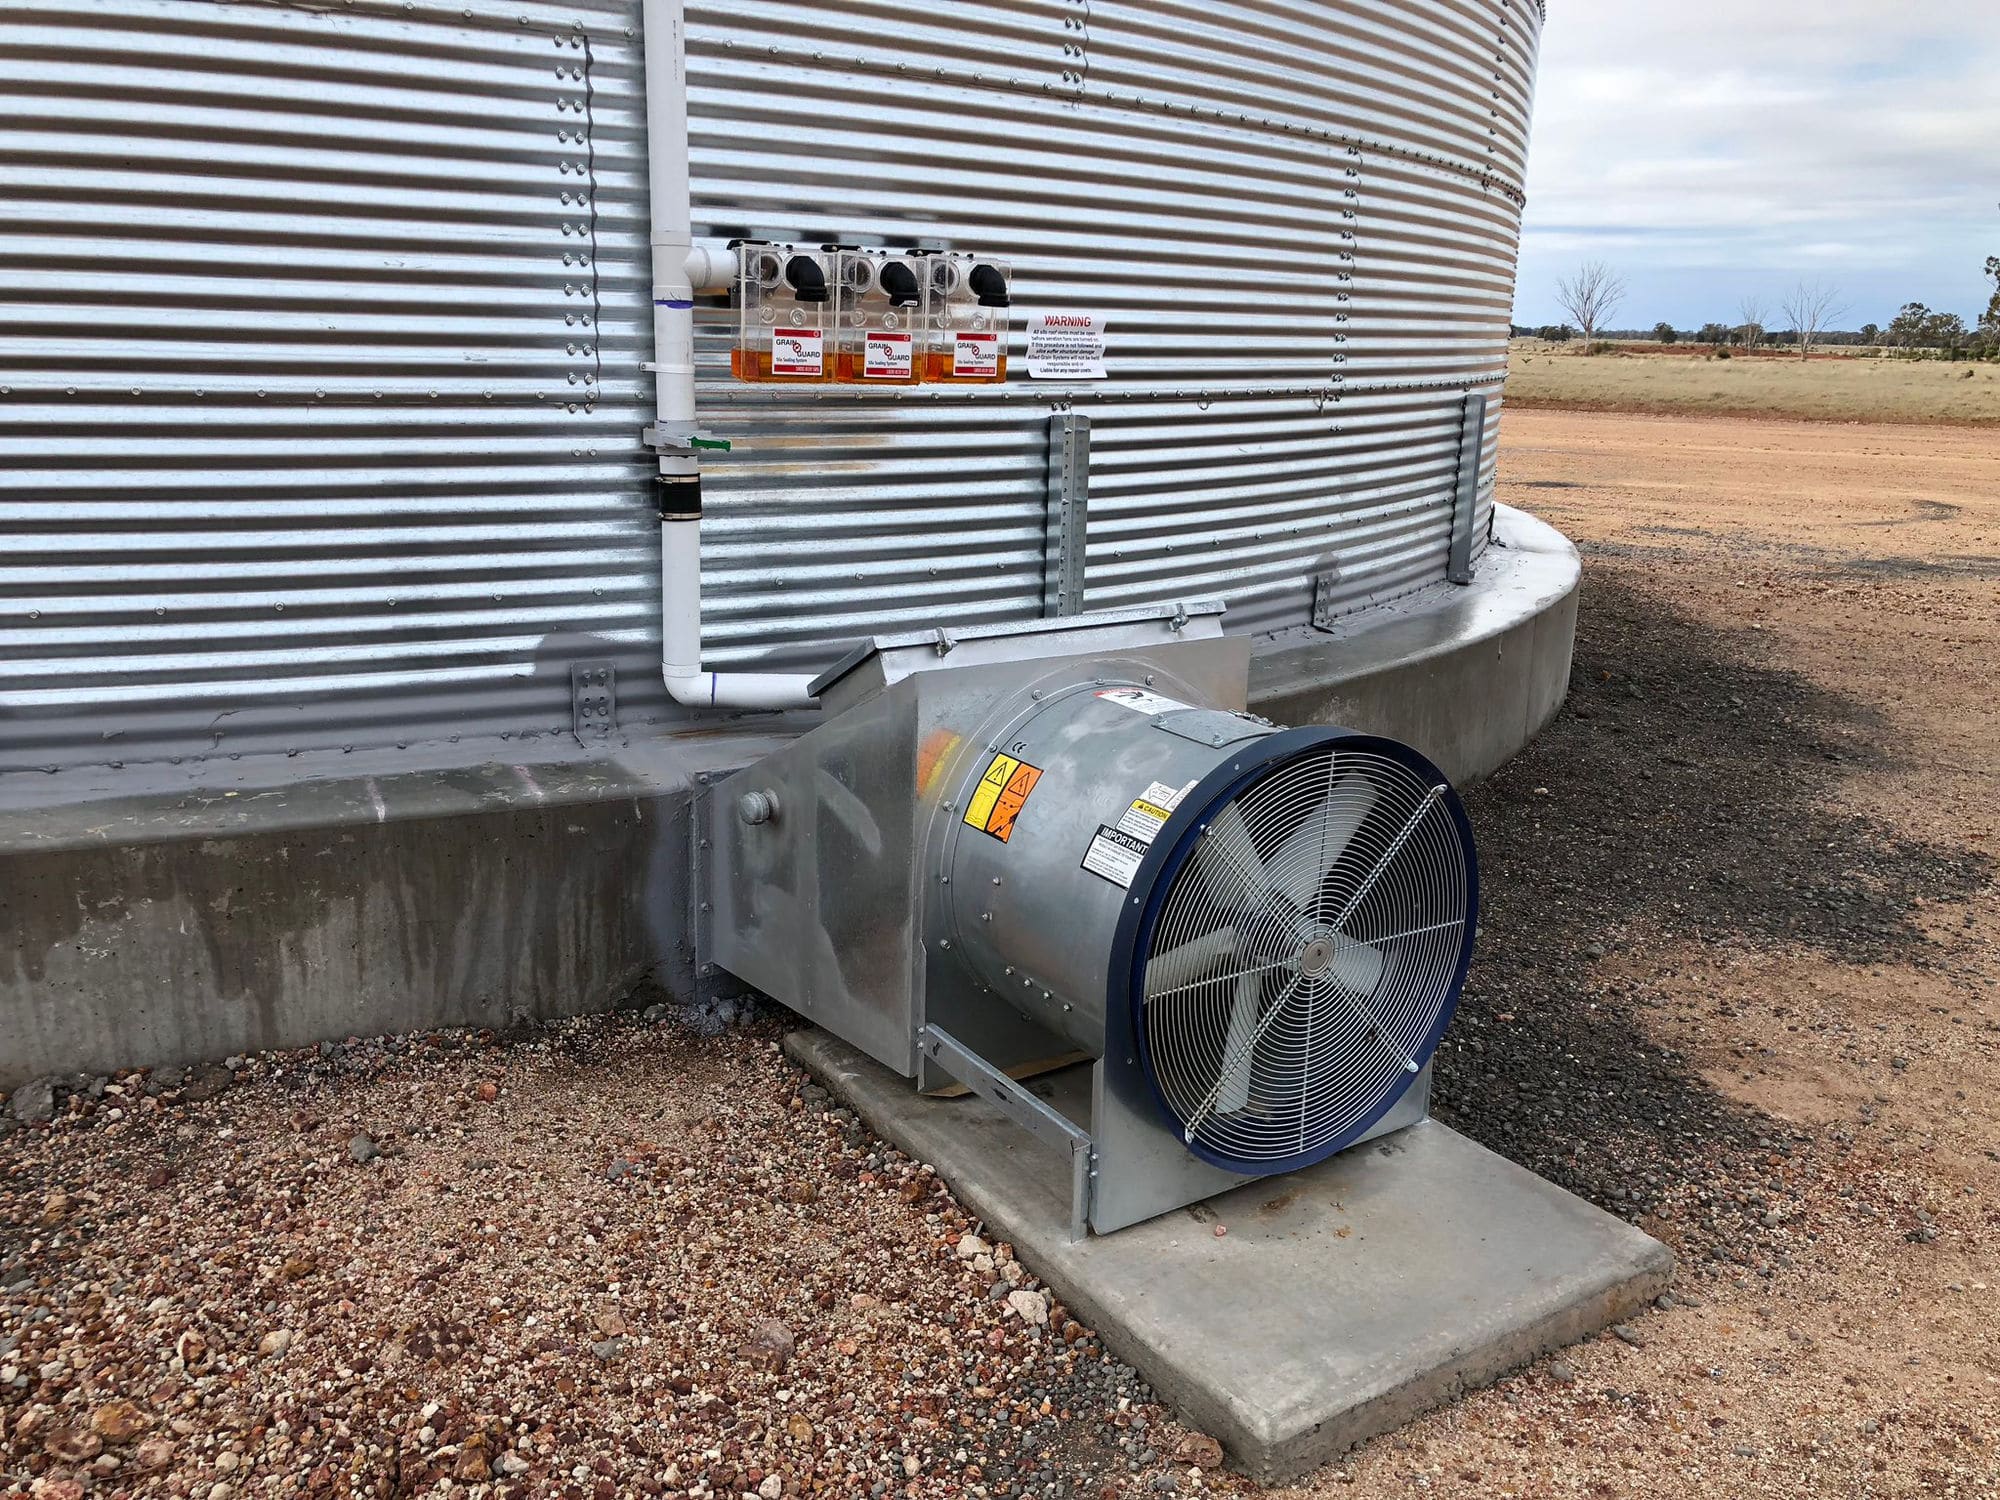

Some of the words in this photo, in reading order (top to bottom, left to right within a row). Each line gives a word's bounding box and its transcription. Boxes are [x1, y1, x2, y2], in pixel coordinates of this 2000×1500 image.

[1044, 315, 1091, 327] WARNING
[1143, 805, 1167, 819] CAUTION
[1100, 827, 1149, 855] IMPORTANT
